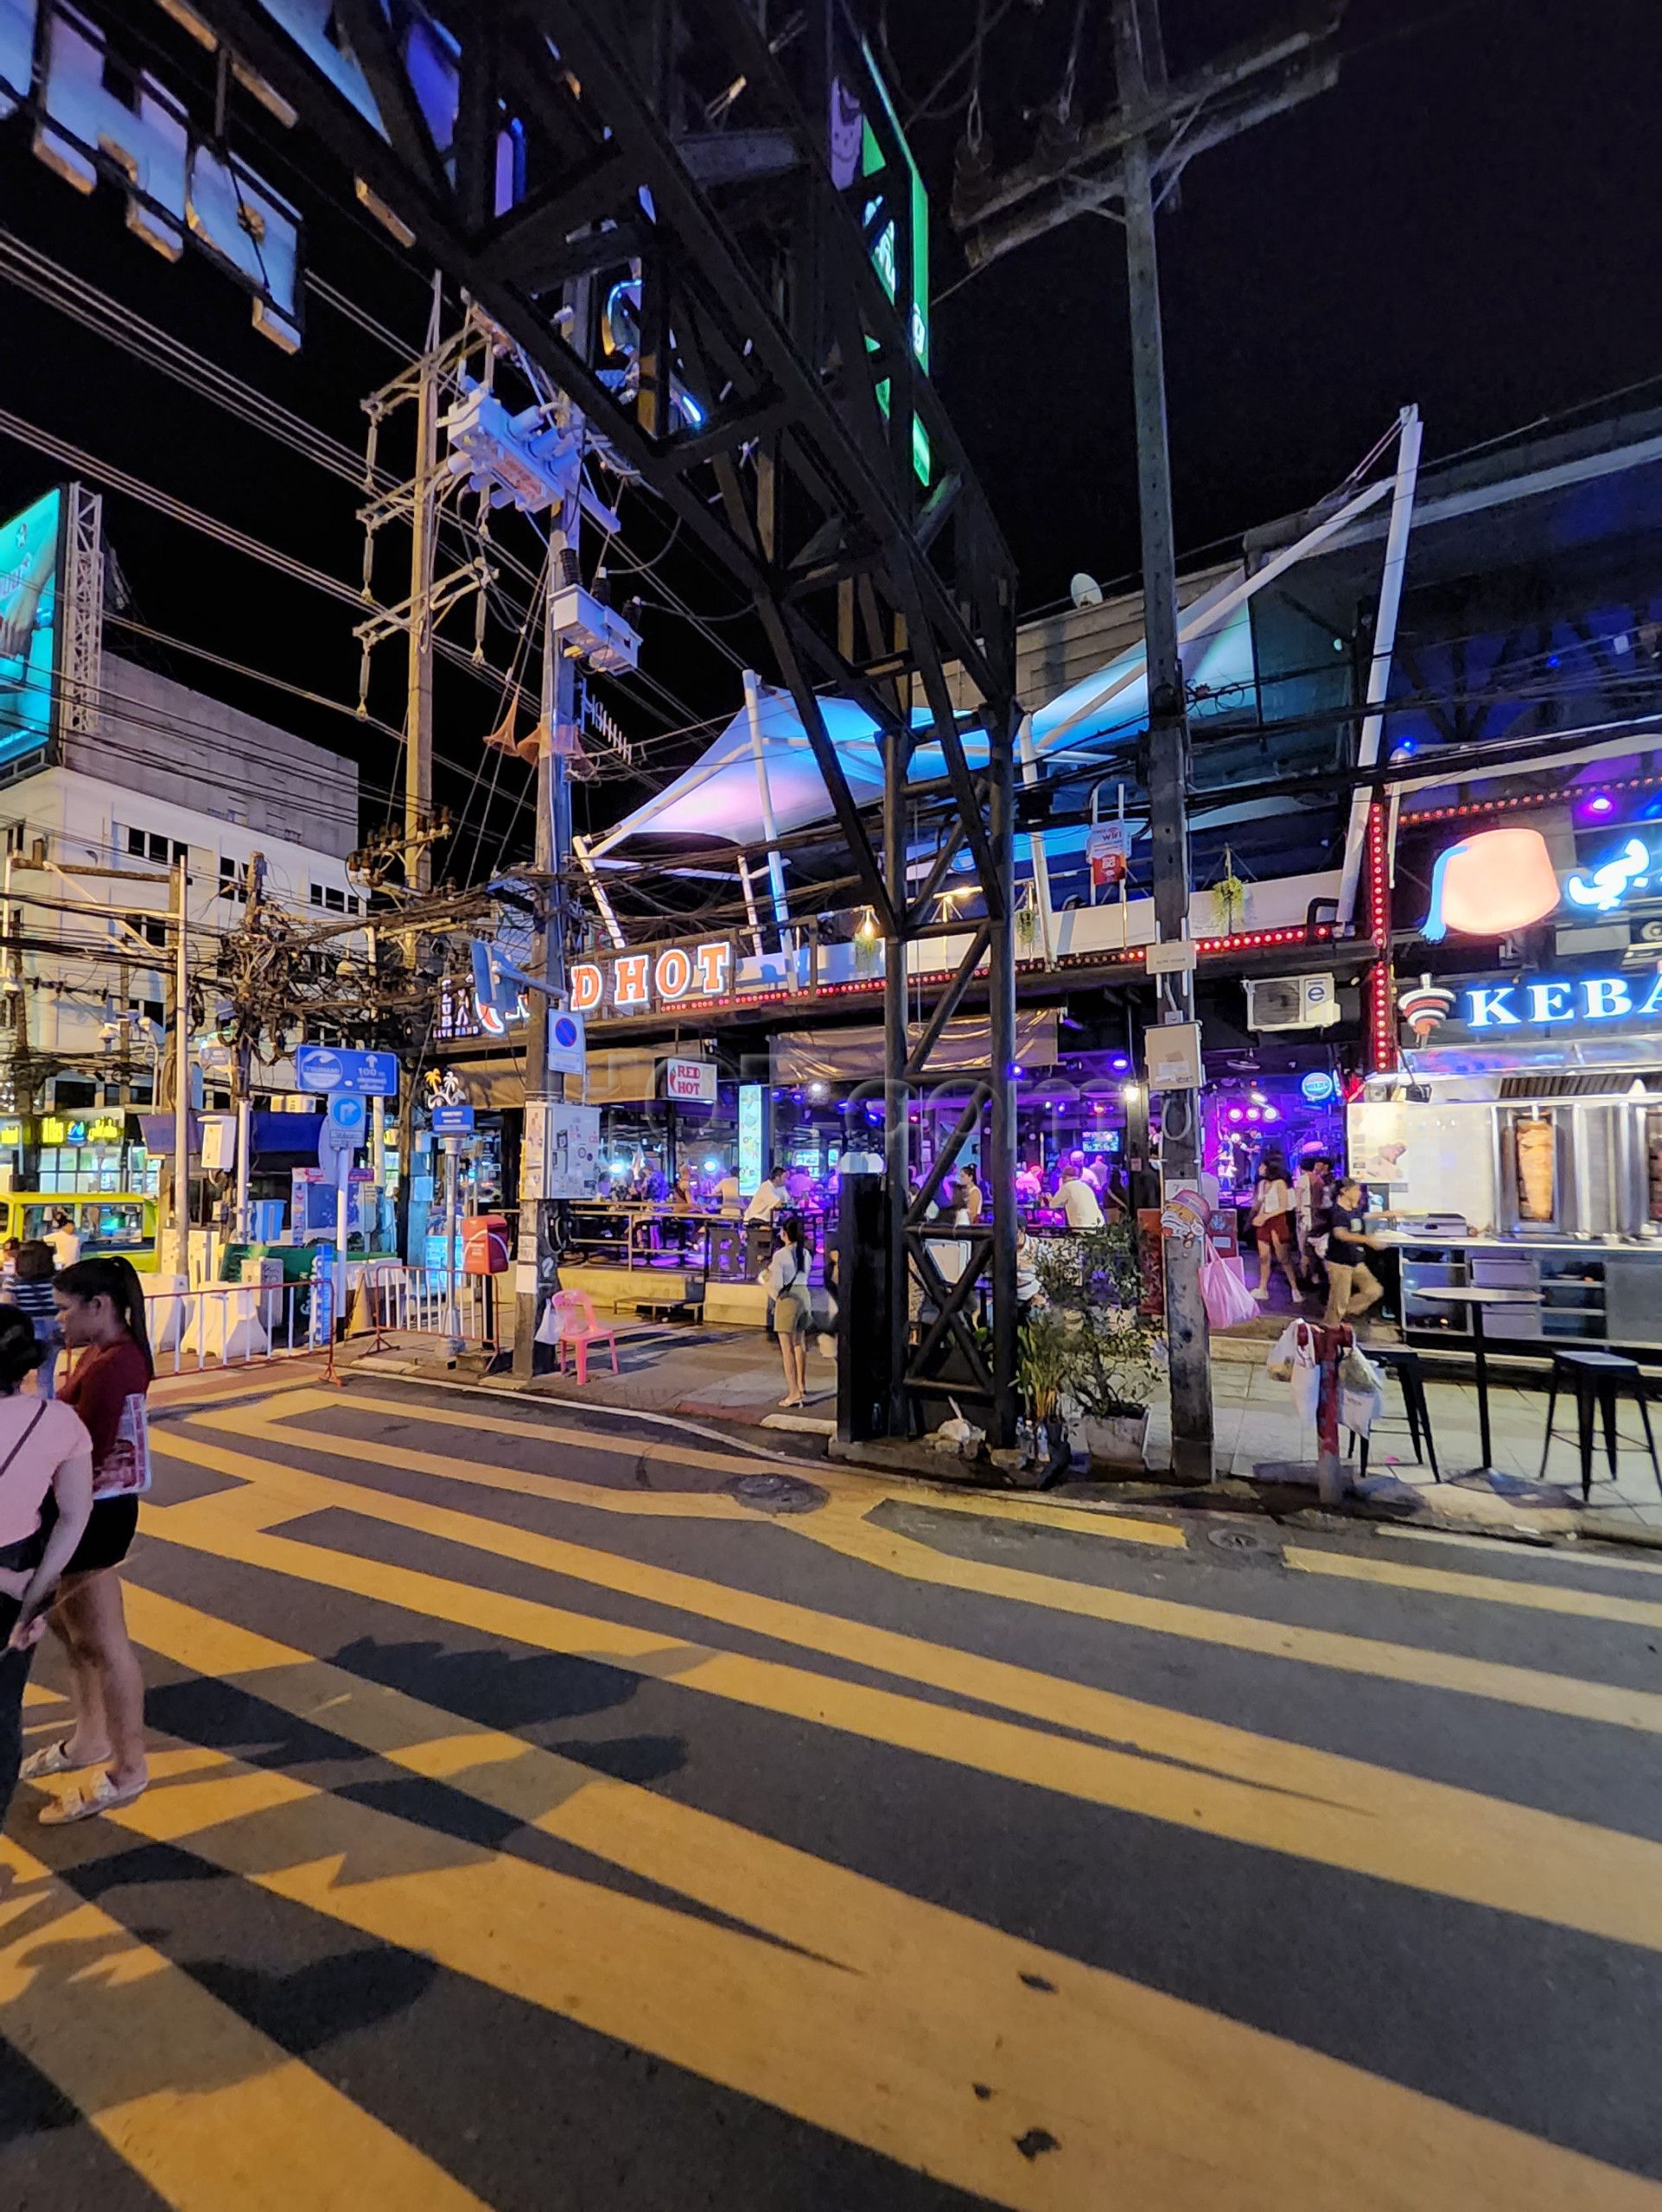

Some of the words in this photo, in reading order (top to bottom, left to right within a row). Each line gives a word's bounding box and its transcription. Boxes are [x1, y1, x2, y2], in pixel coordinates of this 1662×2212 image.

[614, 941, 731, 1007] HOT
[677, 1065, 701, 1079] RED
[678, 1081, 701, 1096] HOT
